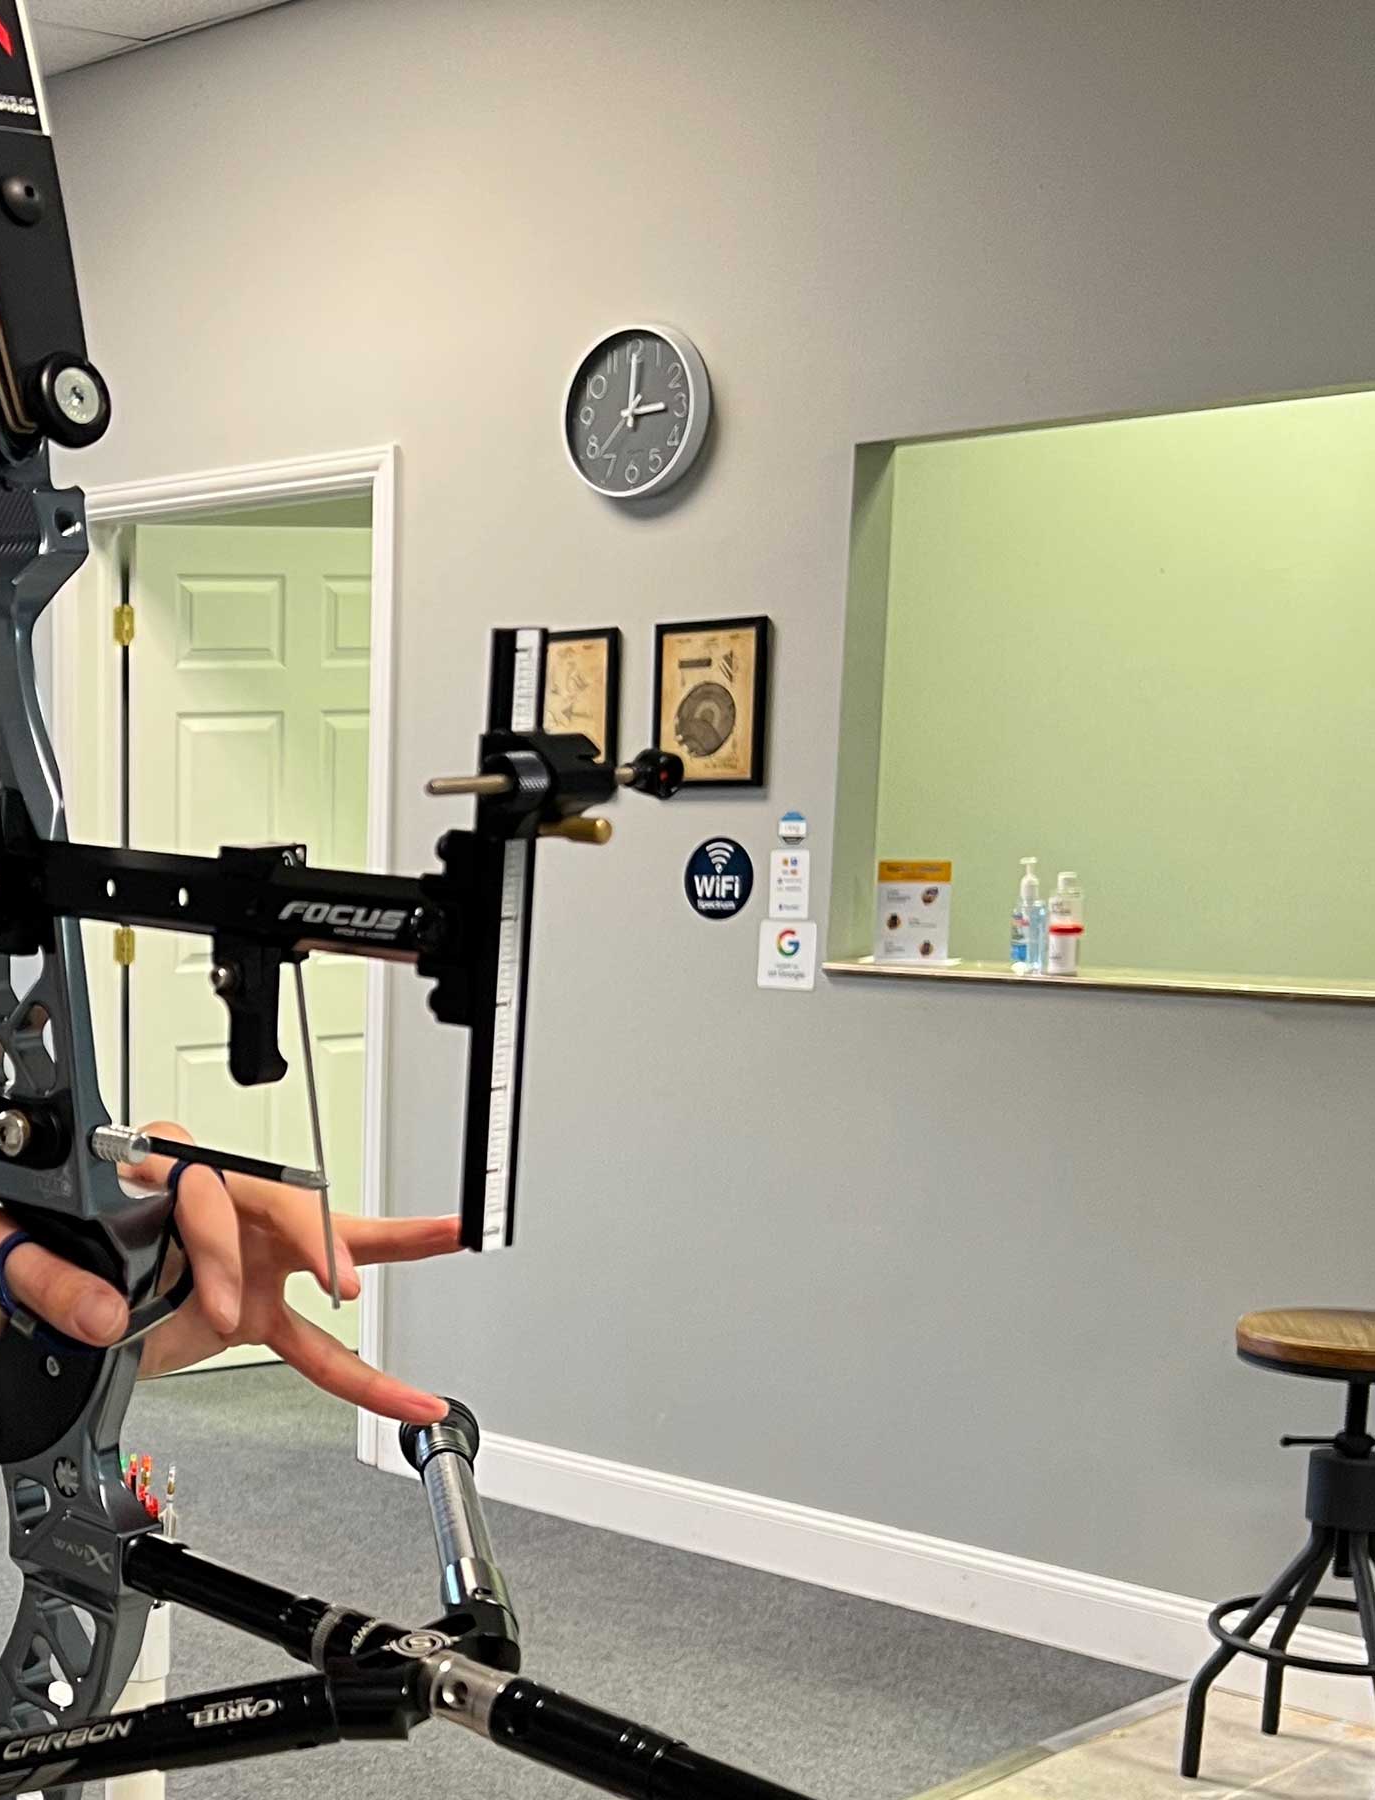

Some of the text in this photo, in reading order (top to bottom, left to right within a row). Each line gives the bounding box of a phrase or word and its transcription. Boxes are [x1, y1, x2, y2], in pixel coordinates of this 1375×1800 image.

[586, 374, 608, 400] 10
[667, 361, 683, 389] 2
[579, 405, 596, 430] 9
[673, 392, 688, 419] 3
[586, 434, 600, 460] 8
[666, 424, 680, 447] 4
[625, 459, 640, 485] 6
[648, 447, 663, 474] 5
[278, 900, 407, 931] FOCUS
[776, 929, 801, 957] G
[2, 1718, 134, 1760] CARBON
